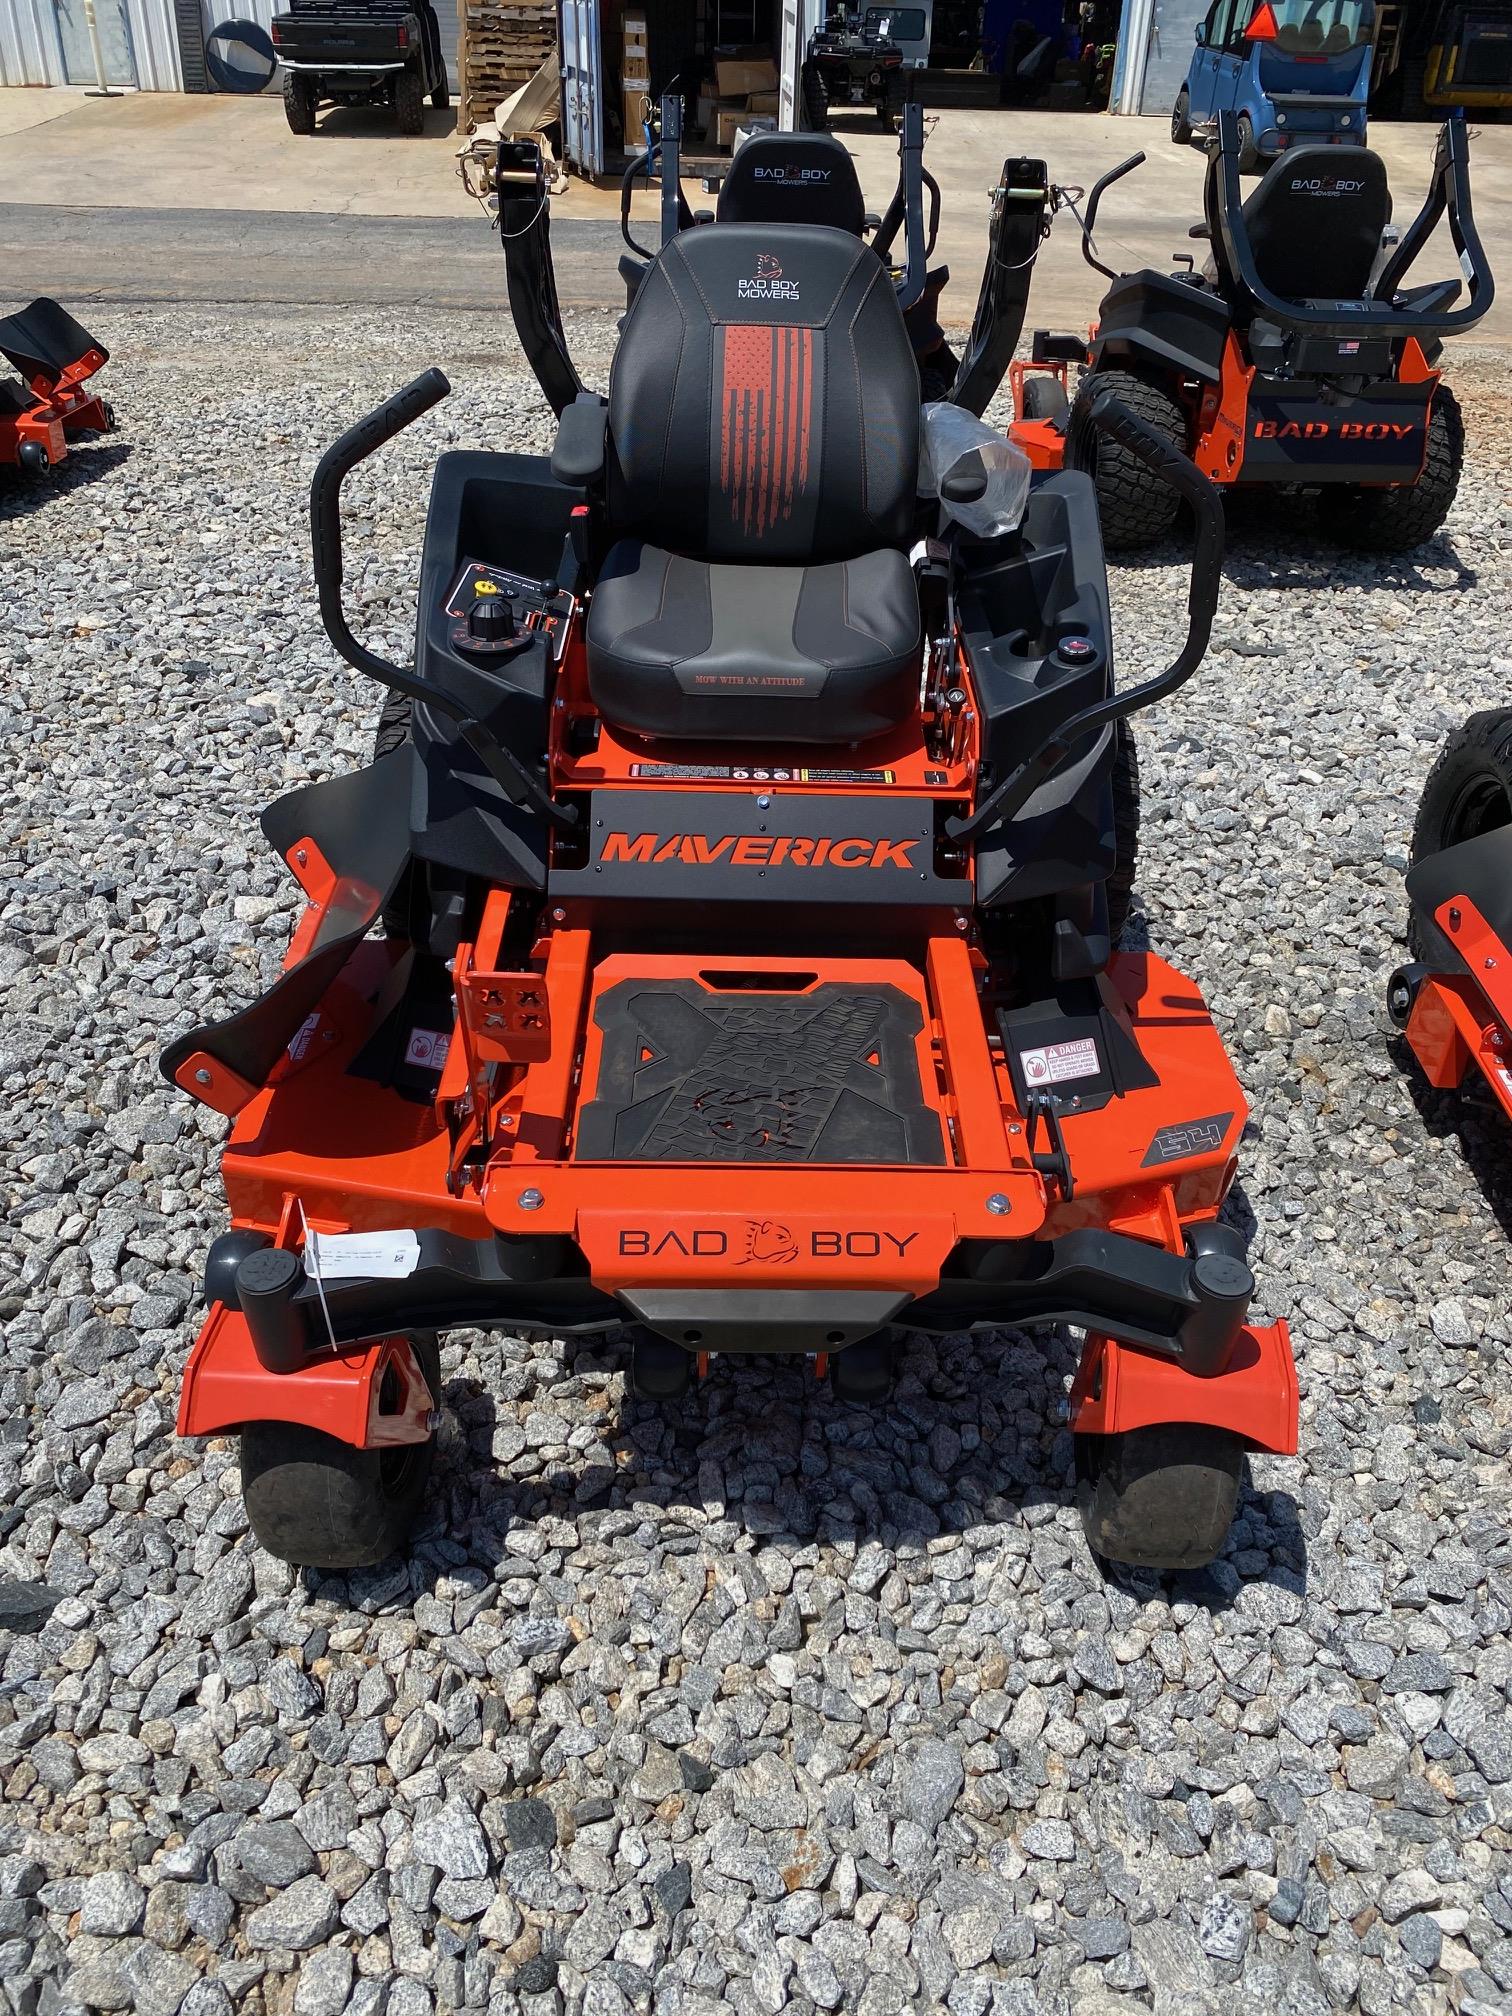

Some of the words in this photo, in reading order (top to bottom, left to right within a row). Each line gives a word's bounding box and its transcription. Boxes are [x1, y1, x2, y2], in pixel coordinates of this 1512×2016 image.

[754, 167, 785, 178] BAD
[801, 169, 832, 180] BOY
[1291, 179, 1321, 190] BAD
[1335, 180, 1366, 191] BOY
[738, 279, 767, 289] BAD
[771, 280, 800, 290] BOY
[738, 289, 800, 300] MOWERS
[1254, 420, 1329, 439] BAD
[1339, 422, 1414, 440] BOY
[695, 675, 716, 685] MOW
[719, 676, 744, 685] WITH
[746, 676, 760, 685] AN
[760, 676, 805, 686] ATTITUDE
[600, 832, 921, 869] MAVERICK
[1059, 1042, 1092, 1055] DANGER
[1154, 1123, 1222, 1157] 54
[618, 1230, 728, 1257] BAD
[811, 1231, 920, 1258] BOY
